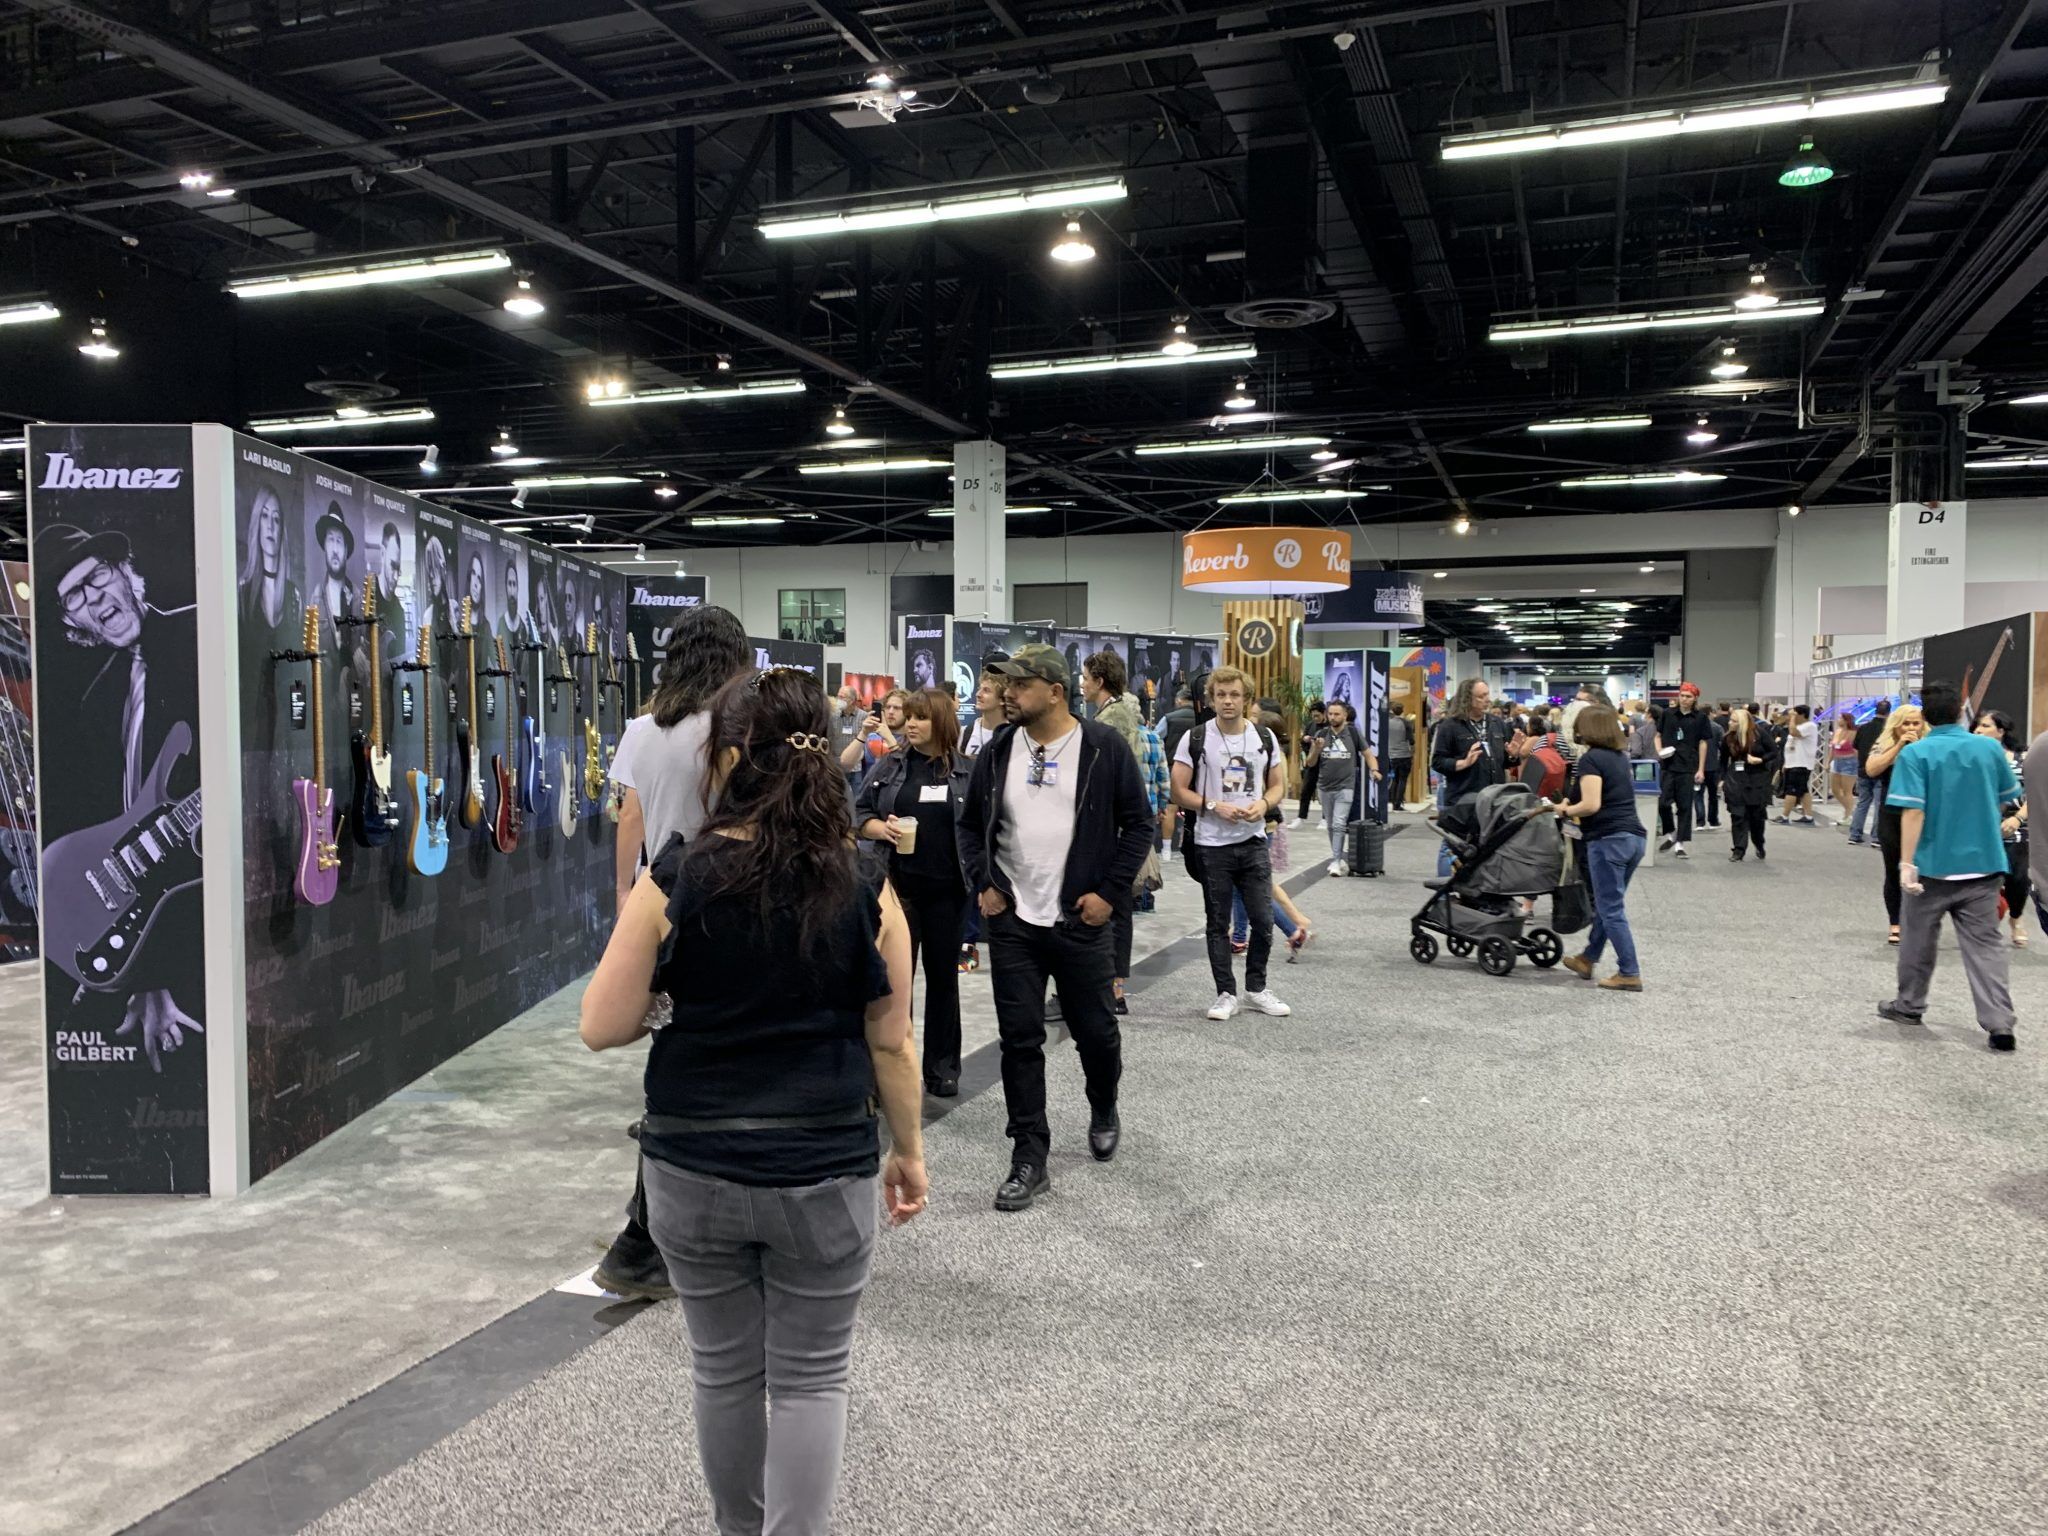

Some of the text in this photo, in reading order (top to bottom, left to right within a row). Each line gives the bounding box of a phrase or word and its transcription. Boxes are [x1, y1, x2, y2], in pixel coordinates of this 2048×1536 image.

[243, 449, 292, 475] LARI BASILIO
[37, 452, 181, 489] Ibanez
[315, 474, 352, 496] JOSH SMITH
[962, 478, 980, 490] D5
[1918, 510, 1945, 524] D4
[629, 586, 700, 606] Ibanez
[1377, 601, 1409, 611] MUSIC
[907, 624, 942, 638] Ibanez
[754, 647, 816, 673] Ibz
[56, 1031, 107, 1045] PAUL
[56, 1046, 137, 1061] GILBERT
